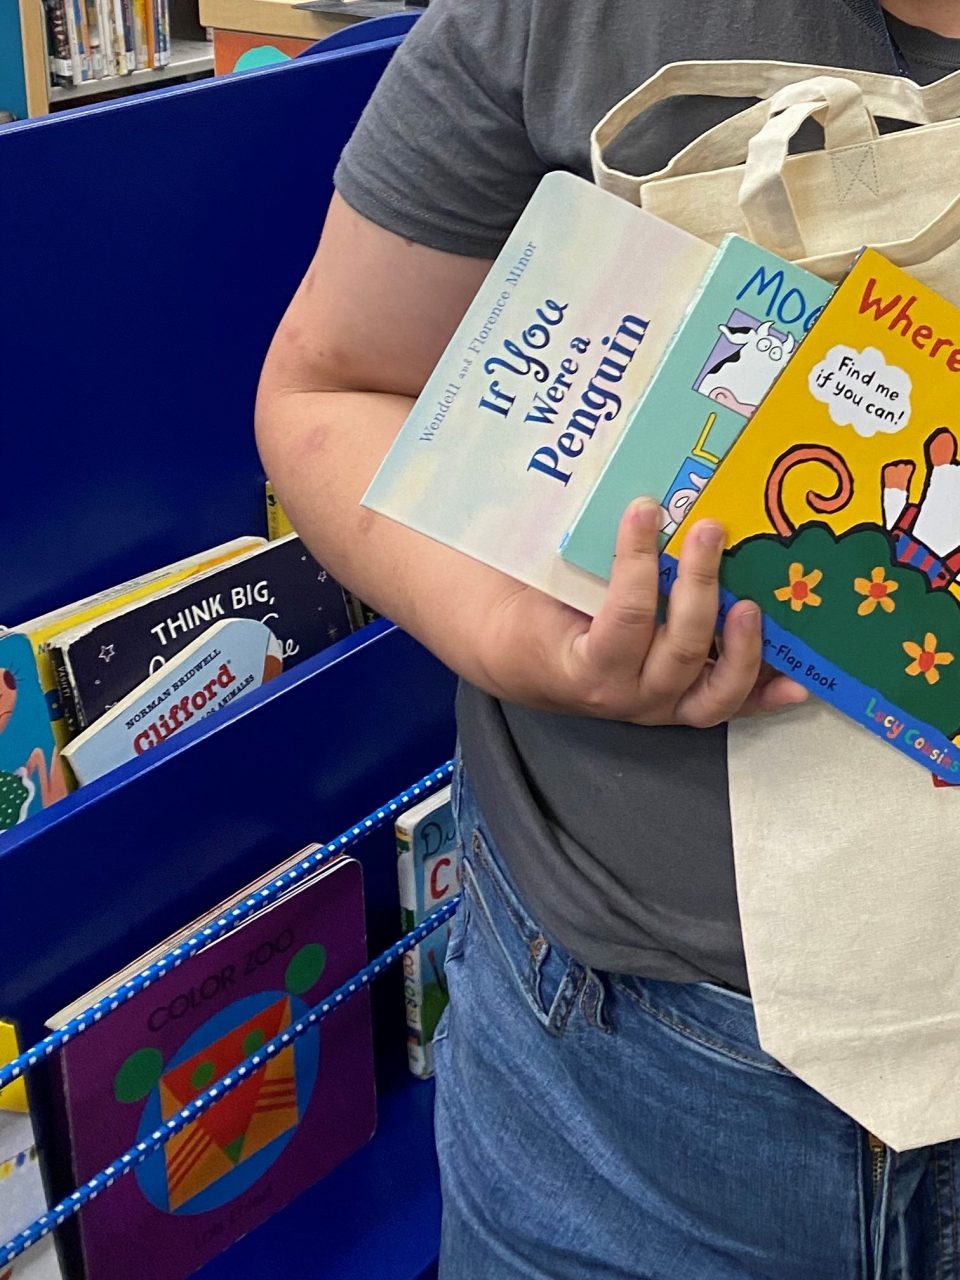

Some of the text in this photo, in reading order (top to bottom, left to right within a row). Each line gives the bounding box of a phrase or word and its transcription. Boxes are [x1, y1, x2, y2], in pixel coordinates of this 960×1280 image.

[418, 239, 538, 444] Wendell and Florence Minor
[476, 298, 569, 420] If You
[837, 355, 901, 405] Find me
[522, 335, 592, 430] Were a
[525, 312, 652, 488] Penguin
[815, 368, 906, 427] if you can!
[150, 580, 276, 646] THINK BIG,
[57, 665, 71, 698] VASHTI
[124, 647, 222, 731] NORMAN BRIDWELL
[132, 663, 237, 756] Clifford
[217, 673, 256, 711] ANIMALES
[804, 663, 839, 693] Book
[864, 697, 960, 773] Lucy Cousins
[146, 927, 296, 1034] COLOR ZOO
